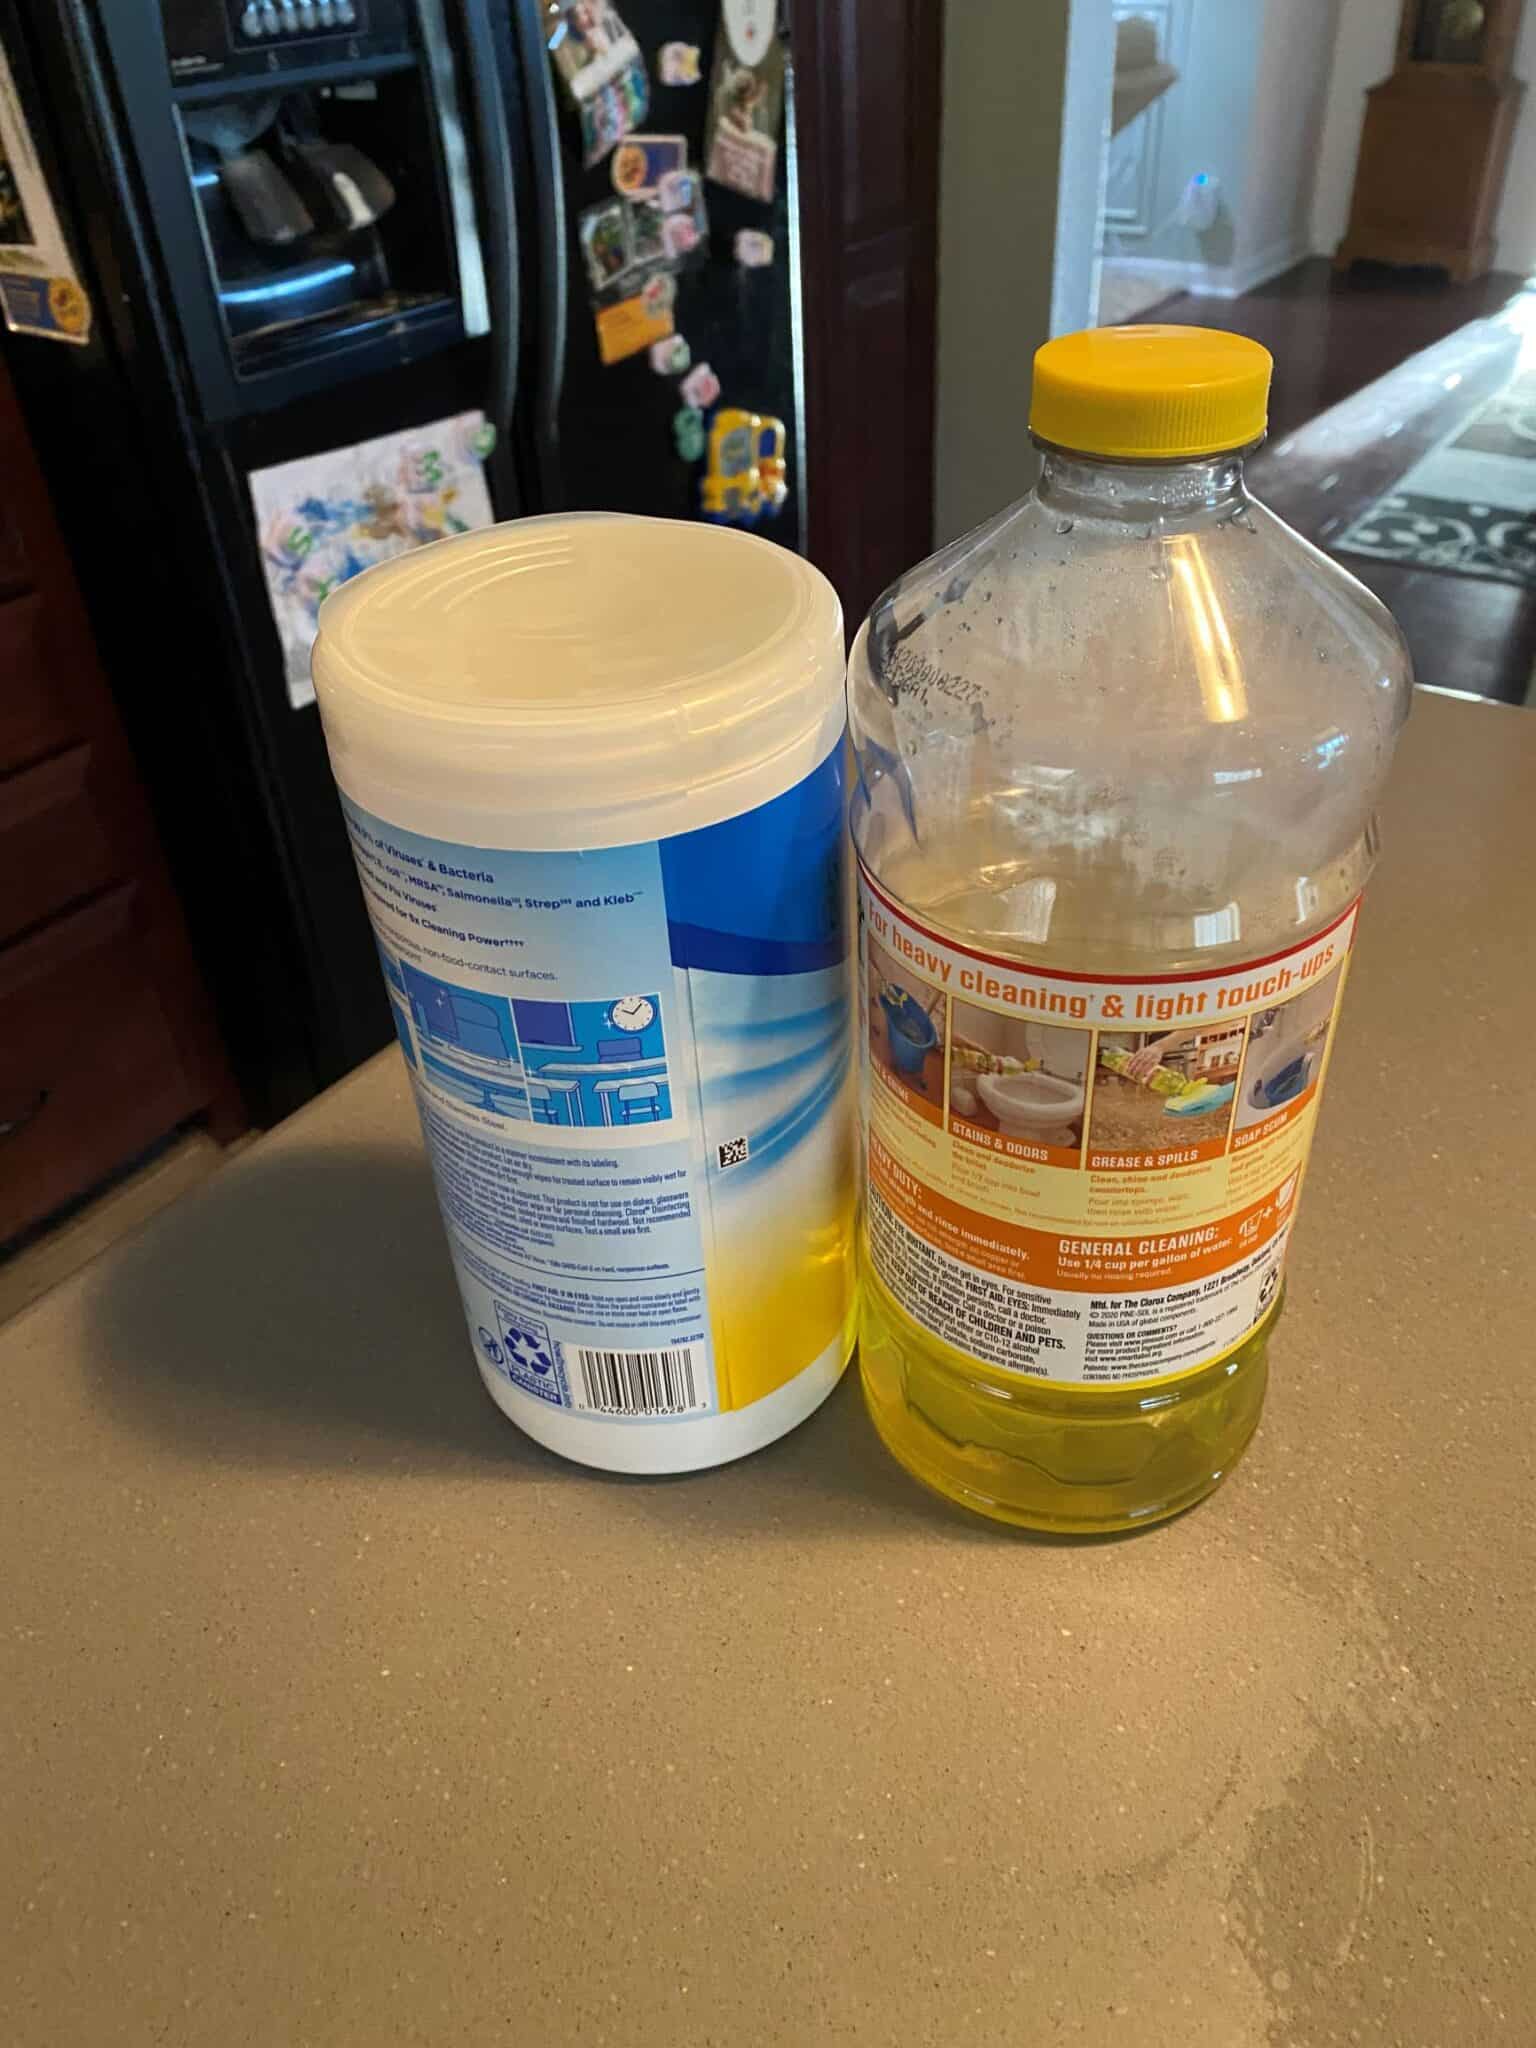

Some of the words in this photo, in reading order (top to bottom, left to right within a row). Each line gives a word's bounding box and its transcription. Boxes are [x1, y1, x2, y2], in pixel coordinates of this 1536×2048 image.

[428, 861, 436, 872] &
[439, 862, 495, 884] Bacteria
[575, 897, 601, 909] and
[421, 917, 467, 943] Cleaning
[509, 969, 559, 981] surfaces.
[892, 924, 952, 983] heavy
[1101, 994, 1124, 1018] &
[1135, 991, 1209, 1021] light
[1216, 943, 1335, 1010] touch-ups
[952, 1121, 991, 1146] STAINS
[995, 1138, 1003, 1150] &
[1006, 1141, 1049, 1161] ODORS
[1233, 1129, 1263, 1149] SOAP
[1263, 1112, 1289, 1134] SCUM
[1091, 1154, 1141, 1168] GREASE
[1144, 1153, 1153, 1167] &
[1157, 1150, 1199, 1166] SPILLS
[892, 1168, 923, 1200] DUTY:
[1090, 1175, 1119, 1186] Clean,
[1150, 1173, 1167, 1183] and
[934, 1214, 959, 1234] rinse
[961, 1226, 1031, 1260] immediately.
[1058, 1238, 1133, 1257] GENERAL
[1139, 1226, 1220, 1255] CLEANING:
[1058, 1256, 1081, 1268] Use
[1085, 1259, 1101, 1269] 1/4
[1104, 1261, 1127, 1271] cup
[1130, 1260, 1149, 1271] per
[1152, 1252, 1187, 1268] gallon
[1190, 1249, 1200, 1258] of
[960, 1270, 971, 1280] get
[982, 1279, 1000, 1292] eyes.
[1002, 1282, 1015, 1295] For
[1016, 1289, 1052, 1305] sensitive
[1110, 1301, 1123, 1309] for
[1124, 1300, 1139, 1309] The
[1140, 1297, 1164, 1308] Clorox
[1166, 1287, 1201, 1303] Company,
[1203, 1279, 1220, 1293] 1221
[965, 1281, 986, 1297] FIRST
[988, 1290, 1005, 1304] AID:
[1007, 1296, 1030, 1311] EYES:
[1031, 1303, 1081, 1321] Immediately
[928, 1289, 954, 1314] REACH
[956, 1307, 967, 1319] OF
[968, 1314, 1012, 1339] CHILDREN
[1014, 1330, 1036, 1345] AND
[1038, 1336, 1067, 1350] PETS.
[1020, 1312, 1047, 1325] doctor.
[1088, 1320, 1106, 1328] Made
[1116, 1318, 1130, 1327] USA
[1139, 1314, 1160, 1327] global
[1100, 1311, 1119, 1319] 2020
[1086, 1331, 1125, 1341] QUESTIONS
[1137, 1324, 1178, 1338] COMMENTS?
[600, 1405, 640, 1417] 44600
[643, 1405, 685, 1416] 01628
